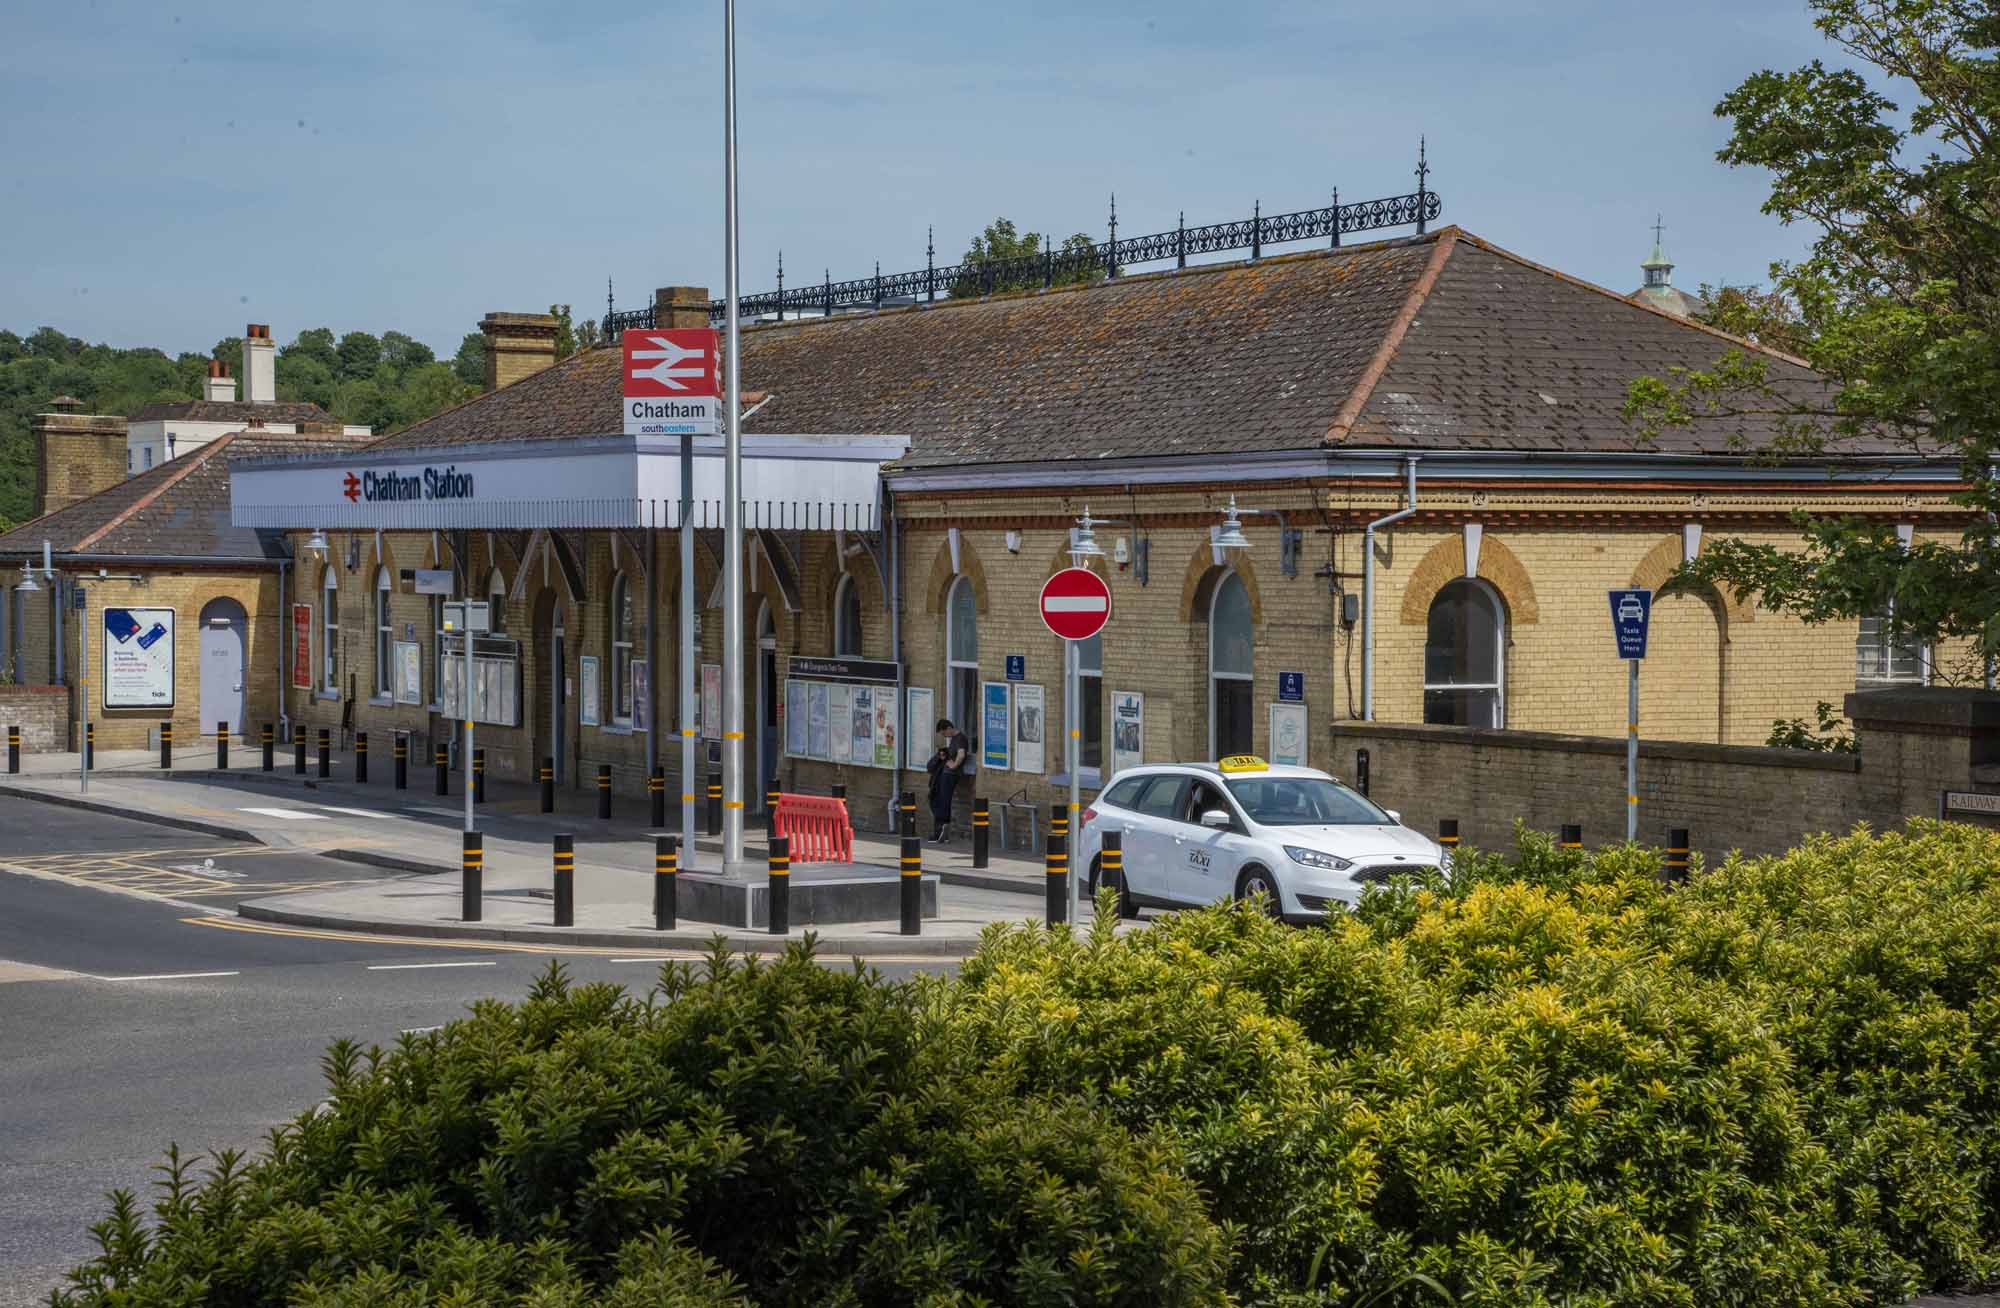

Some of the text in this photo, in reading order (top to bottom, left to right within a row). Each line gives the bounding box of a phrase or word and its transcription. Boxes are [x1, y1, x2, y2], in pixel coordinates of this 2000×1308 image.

[632, 402, 705, 418] Chatham
[641, 424, 696, 433] southeastern
[363, 465, 474, 502] Chatham Station
[1232, 757, 1256, 767] TAXI
[1951, 795, 1997, 810] RAILWAY
[1189, 852, 1211, 867] TAXI
